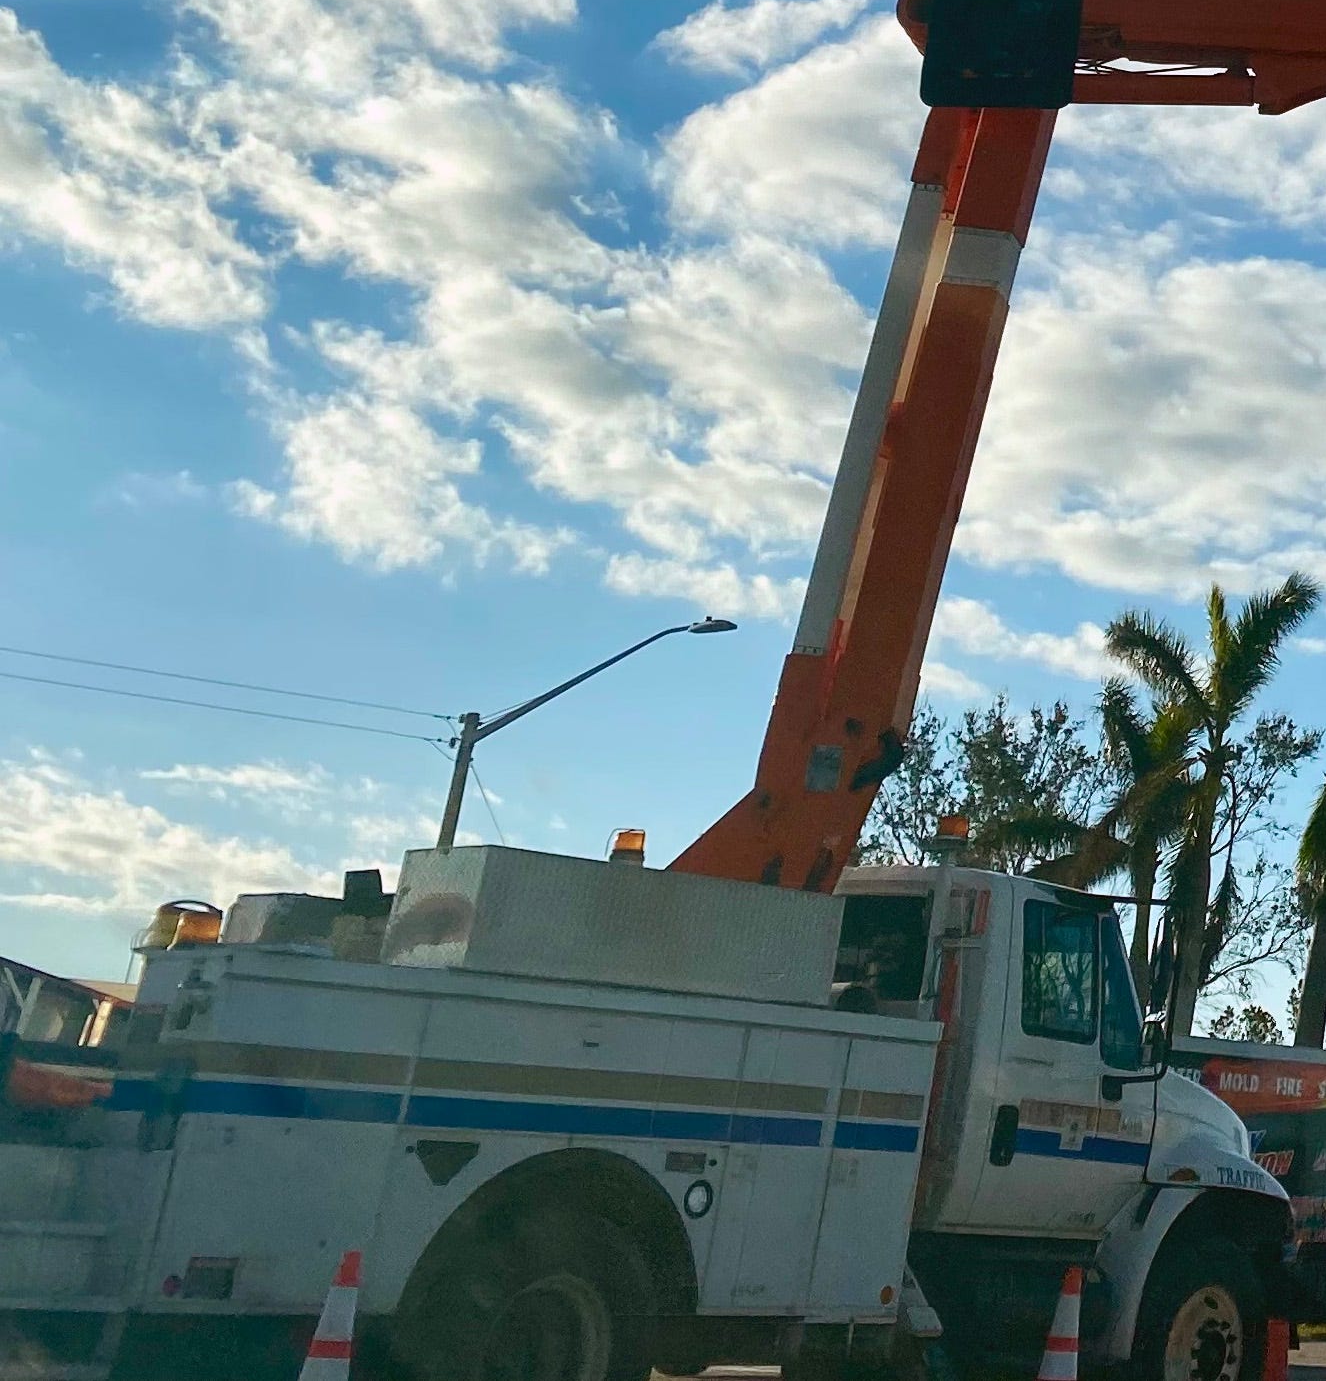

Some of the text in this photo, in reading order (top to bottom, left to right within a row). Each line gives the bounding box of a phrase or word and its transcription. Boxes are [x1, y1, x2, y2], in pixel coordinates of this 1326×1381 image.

[1219, 1072, 1259, 1093] MOLD
[1276, 1076, 1303, 1098] FIRE
[1216, 1167, 1266, 1190] TRAFFIC
